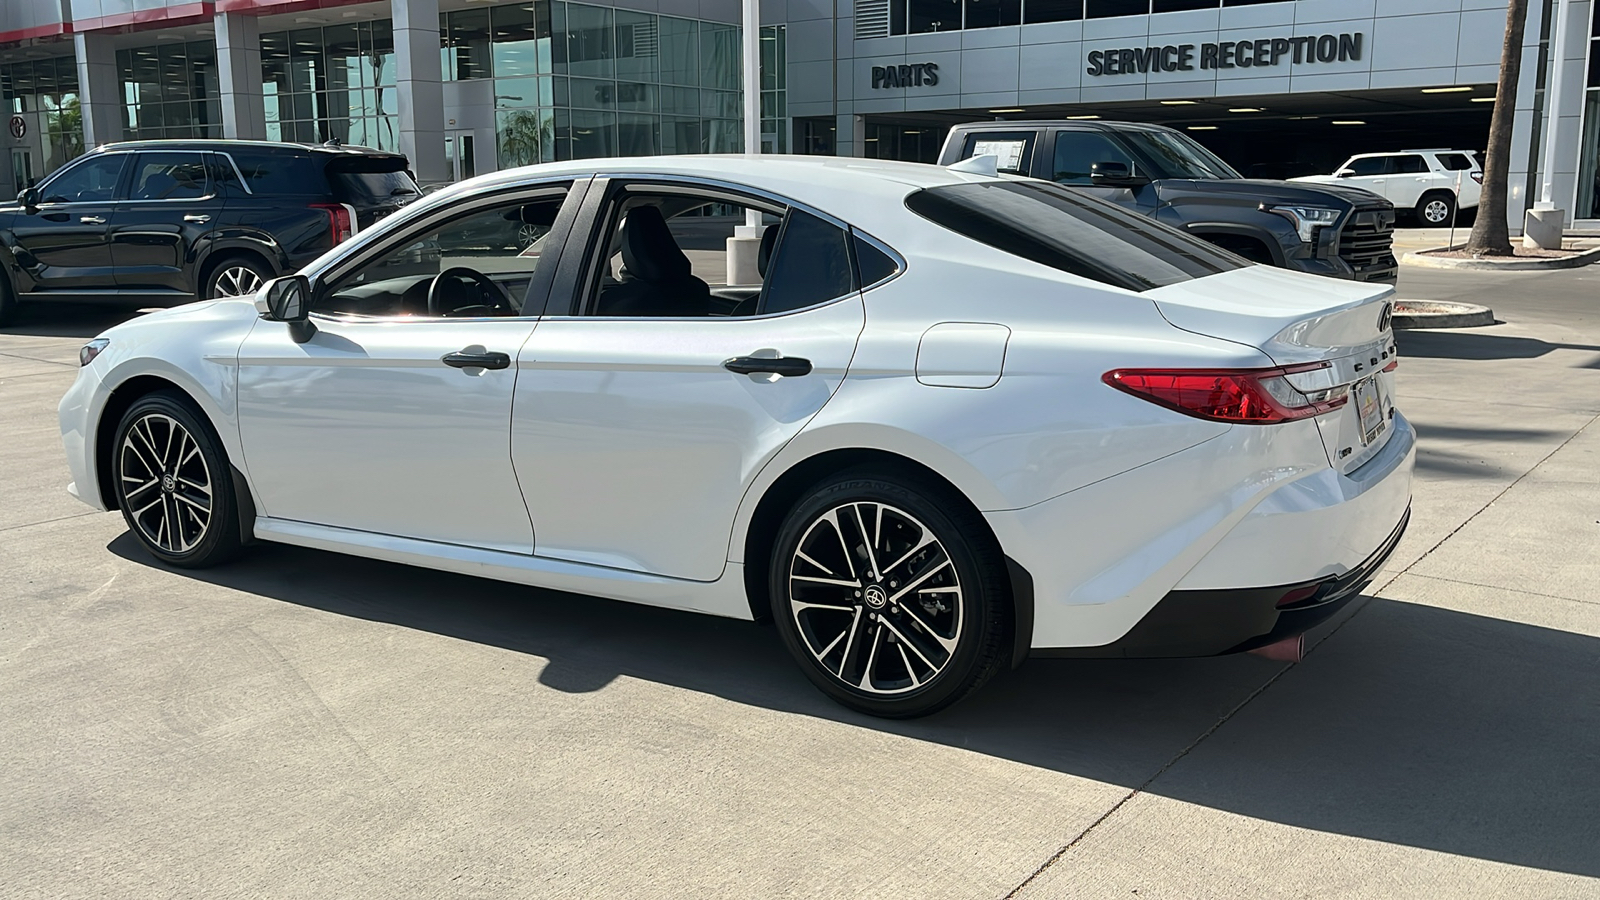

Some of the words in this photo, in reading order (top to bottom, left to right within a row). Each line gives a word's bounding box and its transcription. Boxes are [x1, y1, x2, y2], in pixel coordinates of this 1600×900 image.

[1087, 44, 1194, 76] SERVICE
[1200, 32, 1363, 70] RECEPTION
[872, 62, 939, 89] PARTS
[827, 481, 909, 498] TURANZA
